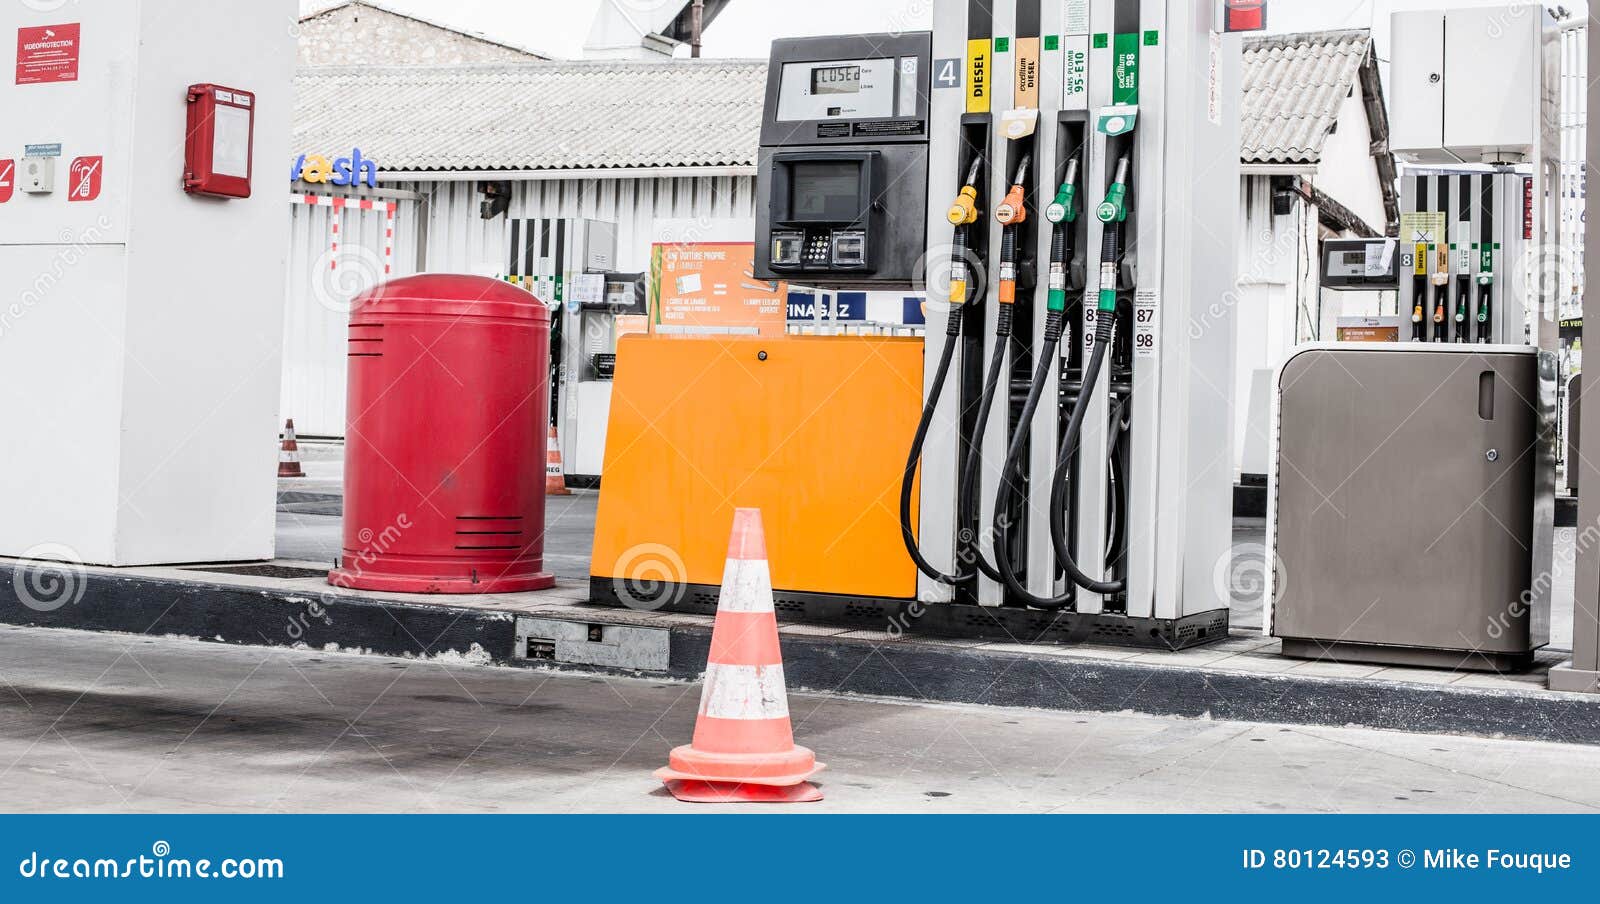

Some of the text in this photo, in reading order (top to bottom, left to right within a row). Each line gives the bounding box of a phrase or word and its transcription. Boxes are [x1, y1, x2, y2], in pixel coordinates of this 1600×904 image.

[1126, 53, 1135, 66] 98
[938, 60, 956, 86] 4
[973, 54, 984, 97] DIESEL
[1402, 254, 1411, 266] 8
[1137, 309, 1154, 322] 87
[1136, 334, 1153, 347] 98
